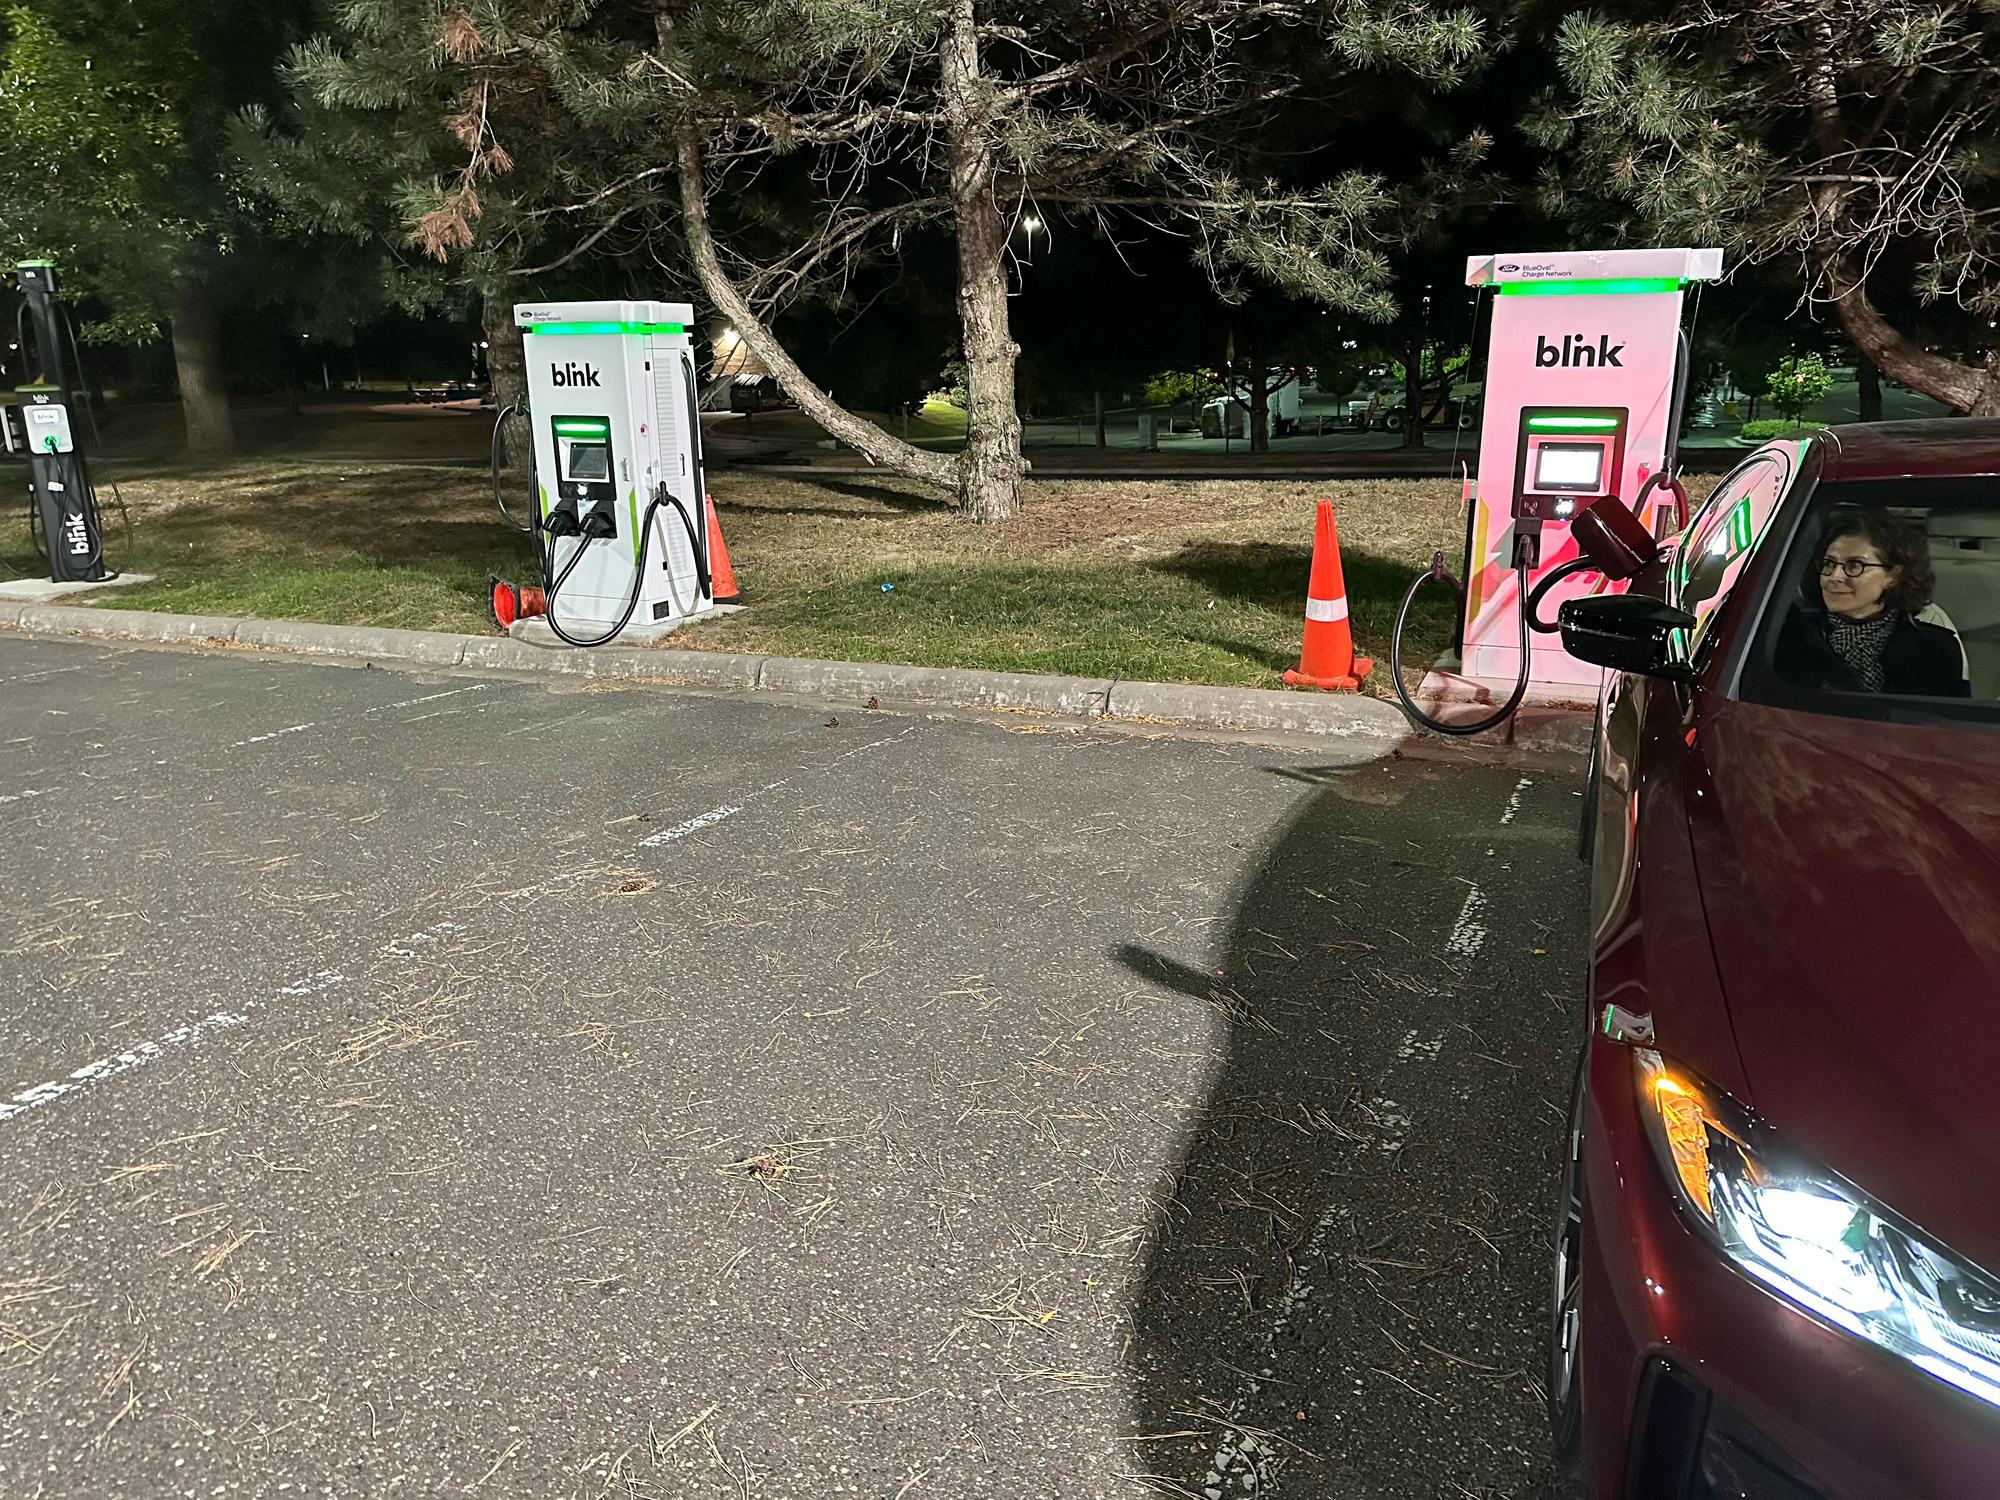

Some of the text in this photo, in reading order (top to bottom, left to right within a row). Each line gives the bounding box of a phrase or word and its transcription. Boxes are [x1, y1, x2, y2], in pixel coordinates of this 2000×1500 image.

[1545, 269, 1573, 277] Network
[1535, 333, 1624, 368] blink
[551, 361, 601, 387] blink
[65, 512, 90, 555] blink
